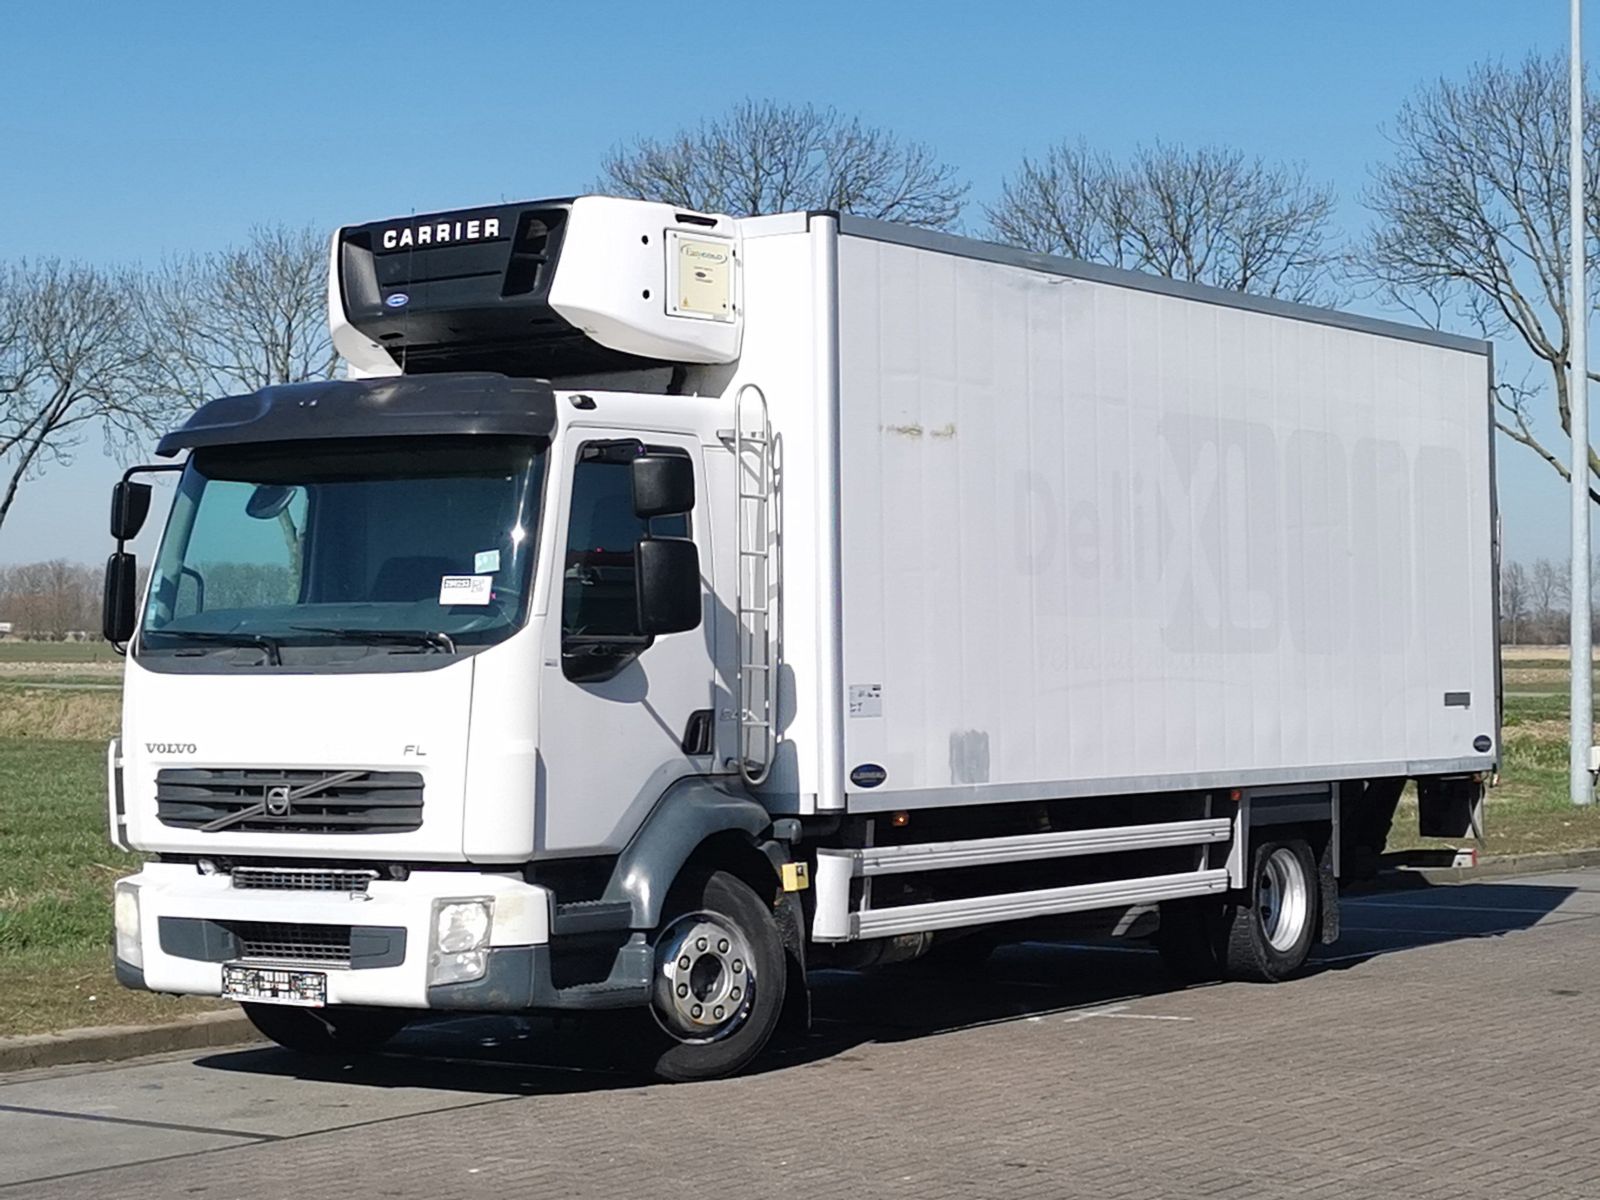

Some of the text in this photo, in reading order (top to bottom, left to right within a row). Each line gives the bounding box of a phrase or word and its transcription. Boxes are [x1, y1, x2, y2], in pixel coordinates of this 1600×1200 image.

[383, 218, 500, 249] CARRIER
[145, 742, 198, 754] VOLVO
[403, 744, 427, 756] FL
